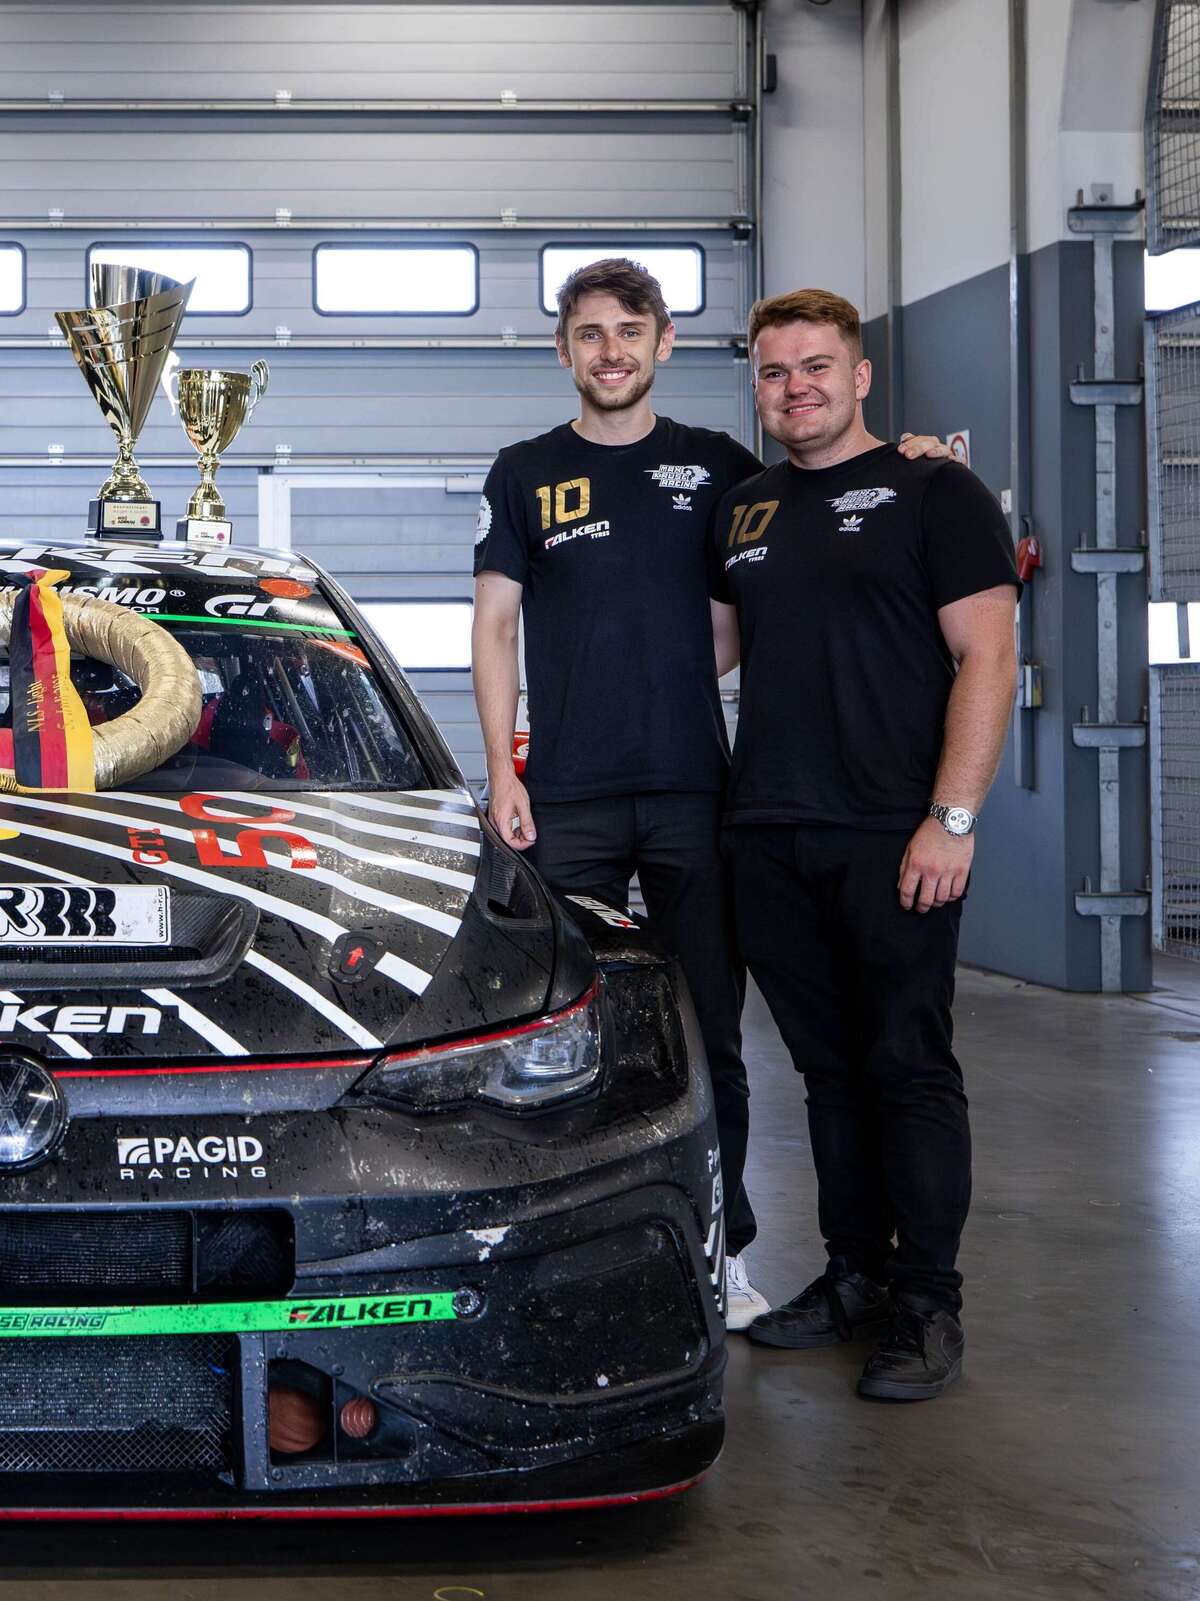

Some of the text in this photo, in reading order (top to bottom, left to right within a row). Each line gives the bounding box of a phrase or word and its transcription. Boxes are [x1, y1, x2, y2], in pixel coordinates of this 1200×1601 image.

[536, 477, 590, 530] 10
[544, 520, 610, 549] FALKEN
[727, 500, 780, 548] 10
[127, 828, 169, 866] GTI
[154, 1136, 263, 1164] PAGID
[120, 1166, 266, 1180] RACING
[29, 1314, 102, 1328] RACING
[288, 1300, 432, 1324] FALKEN
